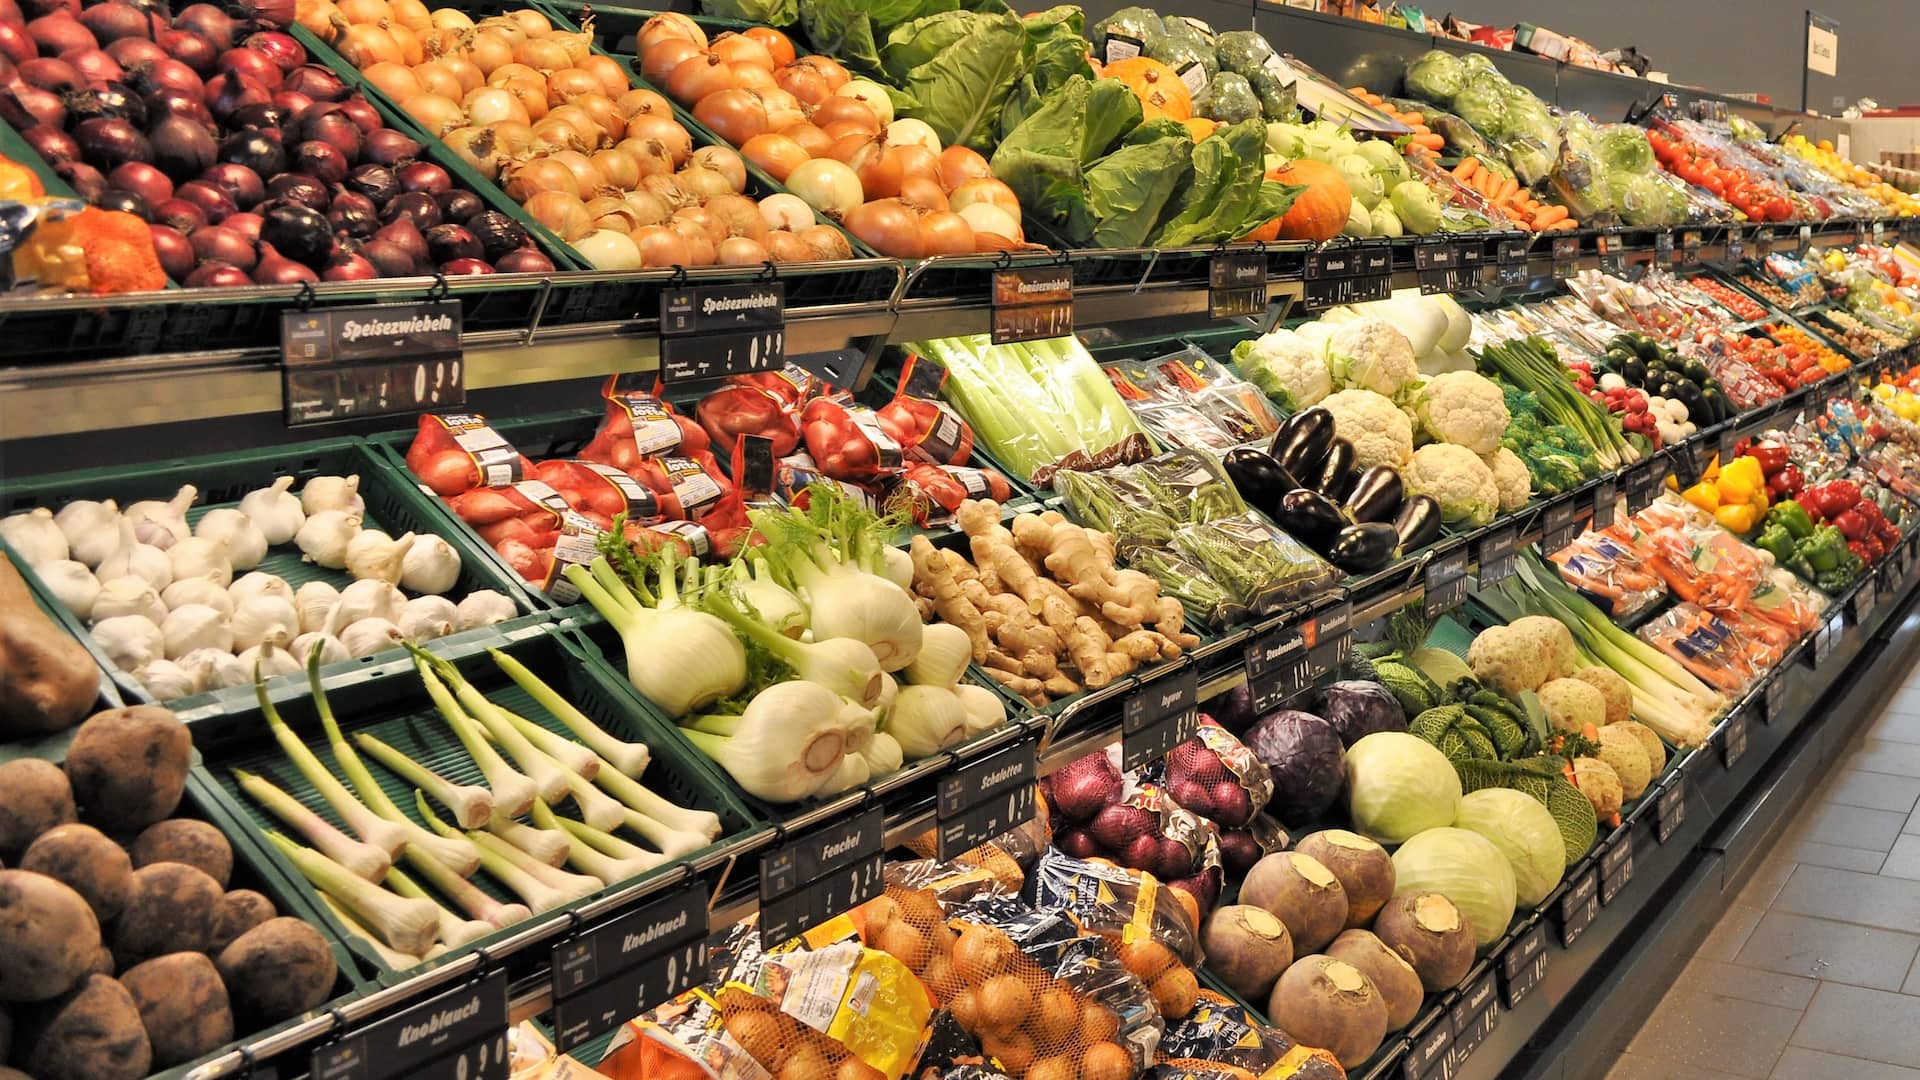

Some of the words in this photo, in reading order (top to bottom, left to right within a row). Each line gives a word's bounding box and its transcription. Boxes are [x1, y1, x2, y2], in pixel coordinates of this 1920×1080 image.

[702, 292, 777, 316] Speisezwiebeln
[342, 313, 452, 342] Speisezwiebeln
[981, 763, 1023, 790] Schalotten
[822, 830, 861, 861] Fenchel
[622, 910, 688, 953] Knoblauch
[398, 996, 480, 1048] Knoblauch
